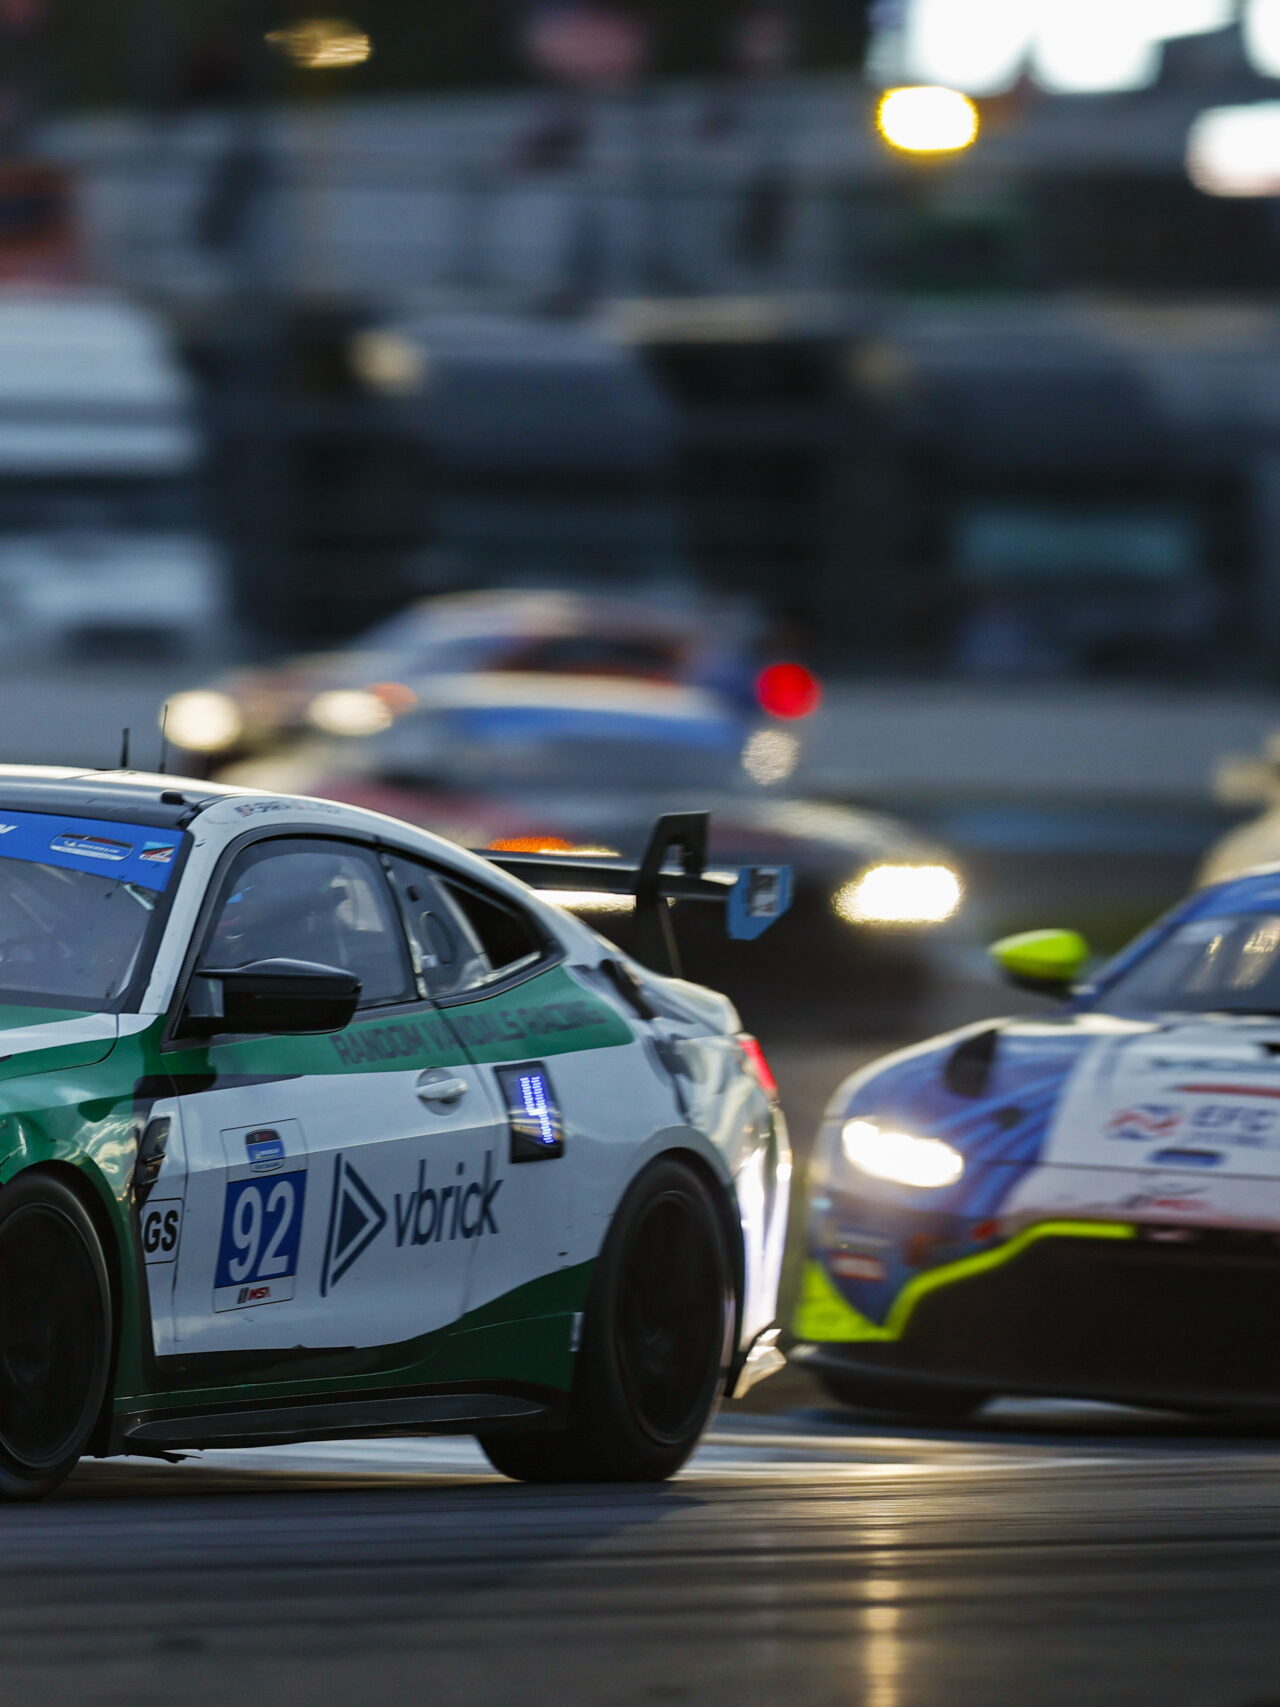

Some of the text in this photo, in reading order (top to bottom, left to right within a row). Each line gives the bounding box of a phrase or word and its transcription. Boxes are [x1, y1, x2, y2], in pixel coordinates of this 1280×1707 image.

[143, 1209, 179, 1253] GS
[228, 1180, 295, 1282] 92
[394, 1149, 504, 1248] vbrick
